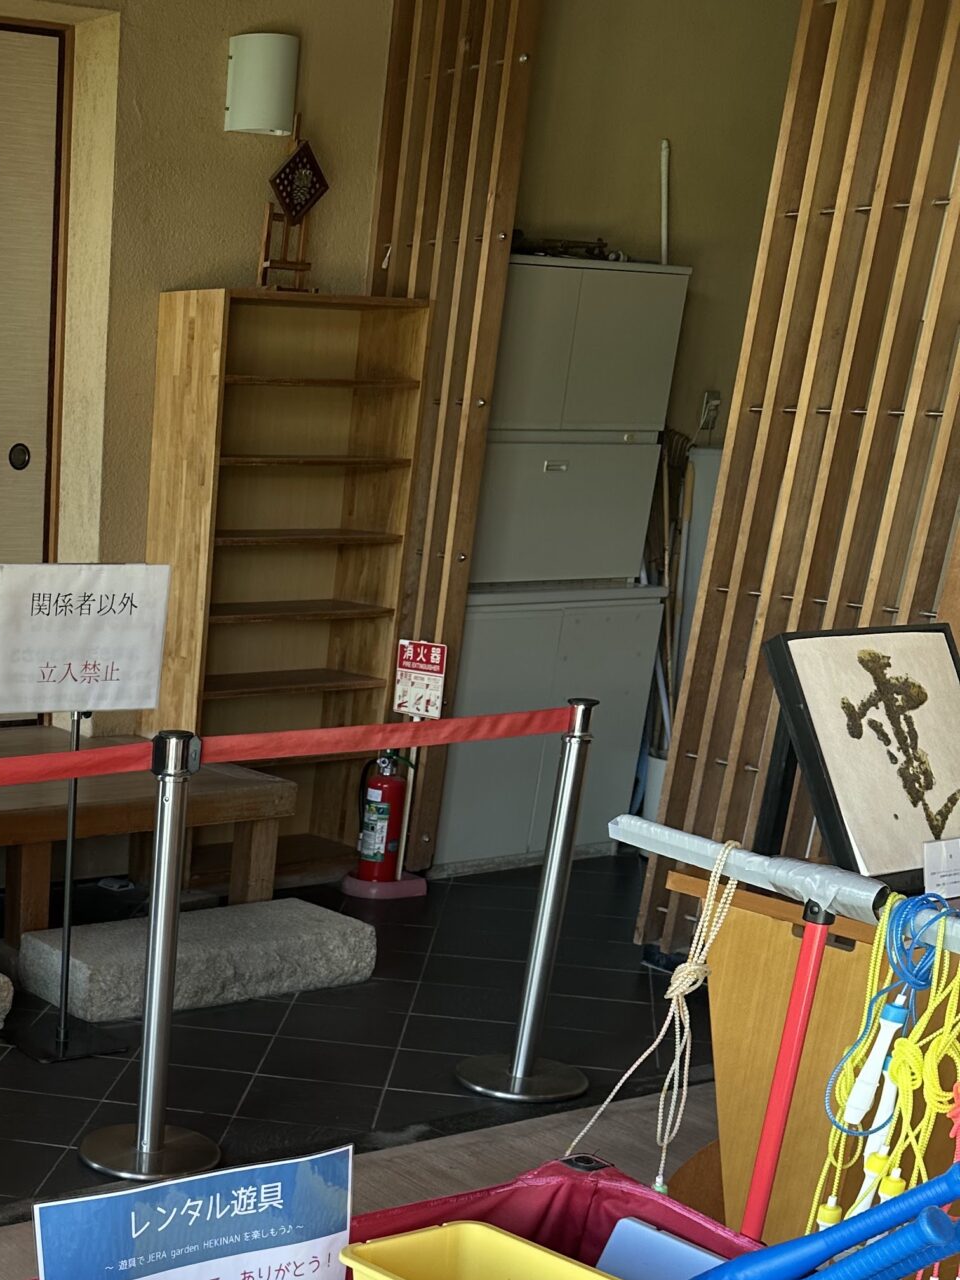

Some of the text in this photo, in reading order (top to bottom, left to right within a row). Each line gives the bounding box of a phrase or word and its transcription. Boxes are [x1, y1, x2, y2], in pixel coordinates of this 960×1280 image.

[30, 591, 138, 616] 関係者以外
[402, 644, 442, 664] 消火器
[36, 660, 121, 684] 立入禁止
[130, 1181, 284, 1240] レンタル遊具
[146, 1251, 167, 1264] JERA
[170, 1244, 200, 1259] garden
[203, 1234, 241, 1249] HEKINAN
